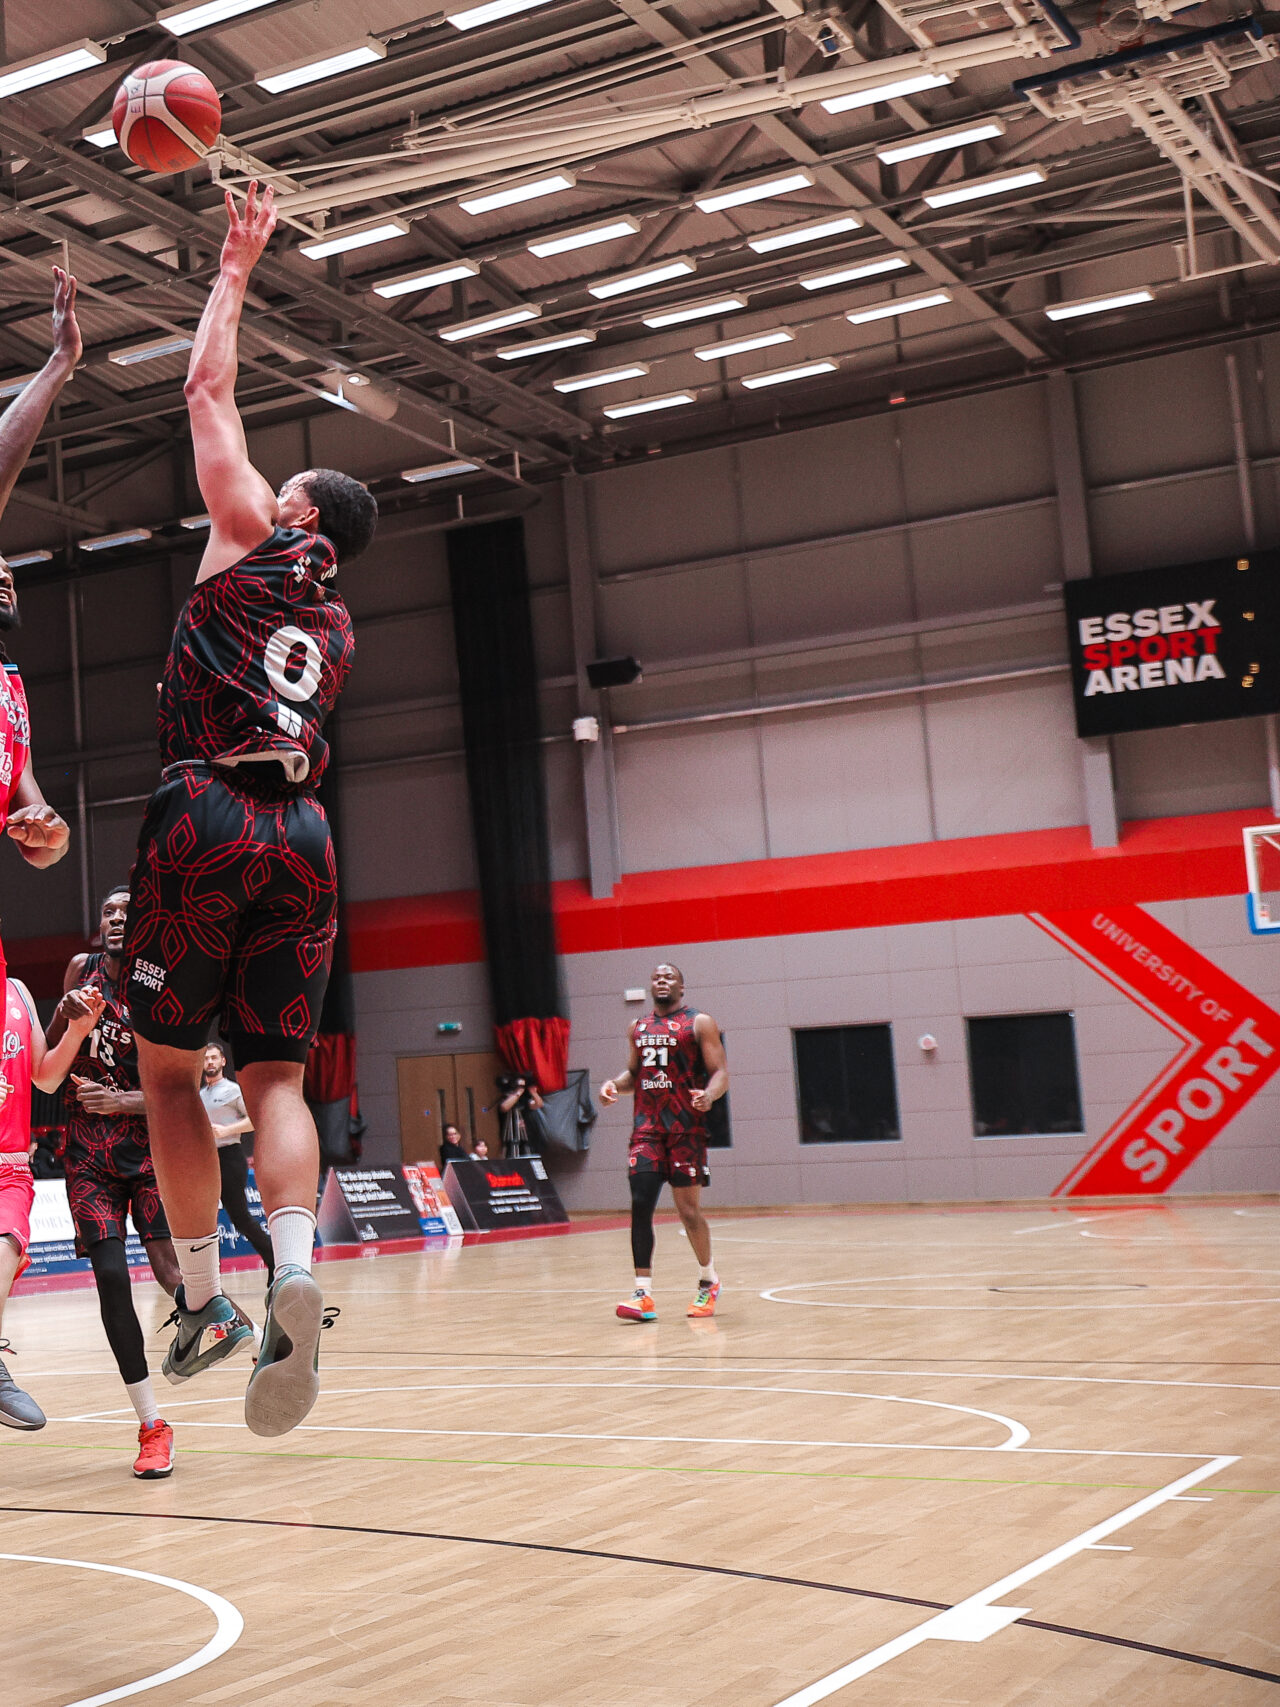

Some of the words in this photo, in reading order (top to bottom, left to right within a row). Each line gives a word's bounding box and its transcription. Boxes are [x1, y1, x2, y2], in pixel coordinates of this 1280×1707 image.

[1078, 599, 1220, 646] ESSEX
[264, 625, 323, 702] 0
[1083, 626, 1222, 672] SPORT
[1083, 653, 1226, 697] ARENA
[132, 970, 164, 992] SPORT
[135, 958, 167, 981] ESSEX
[1091, 912, 1204, 1001] UNIVERSITY
[1199, 998, 1233, 1023] OF
[102, 1024, 132, 1045] ELS
[642, 1047, 669, 1067] 21
[1122, 1017, 1276, 1184] SPORT
